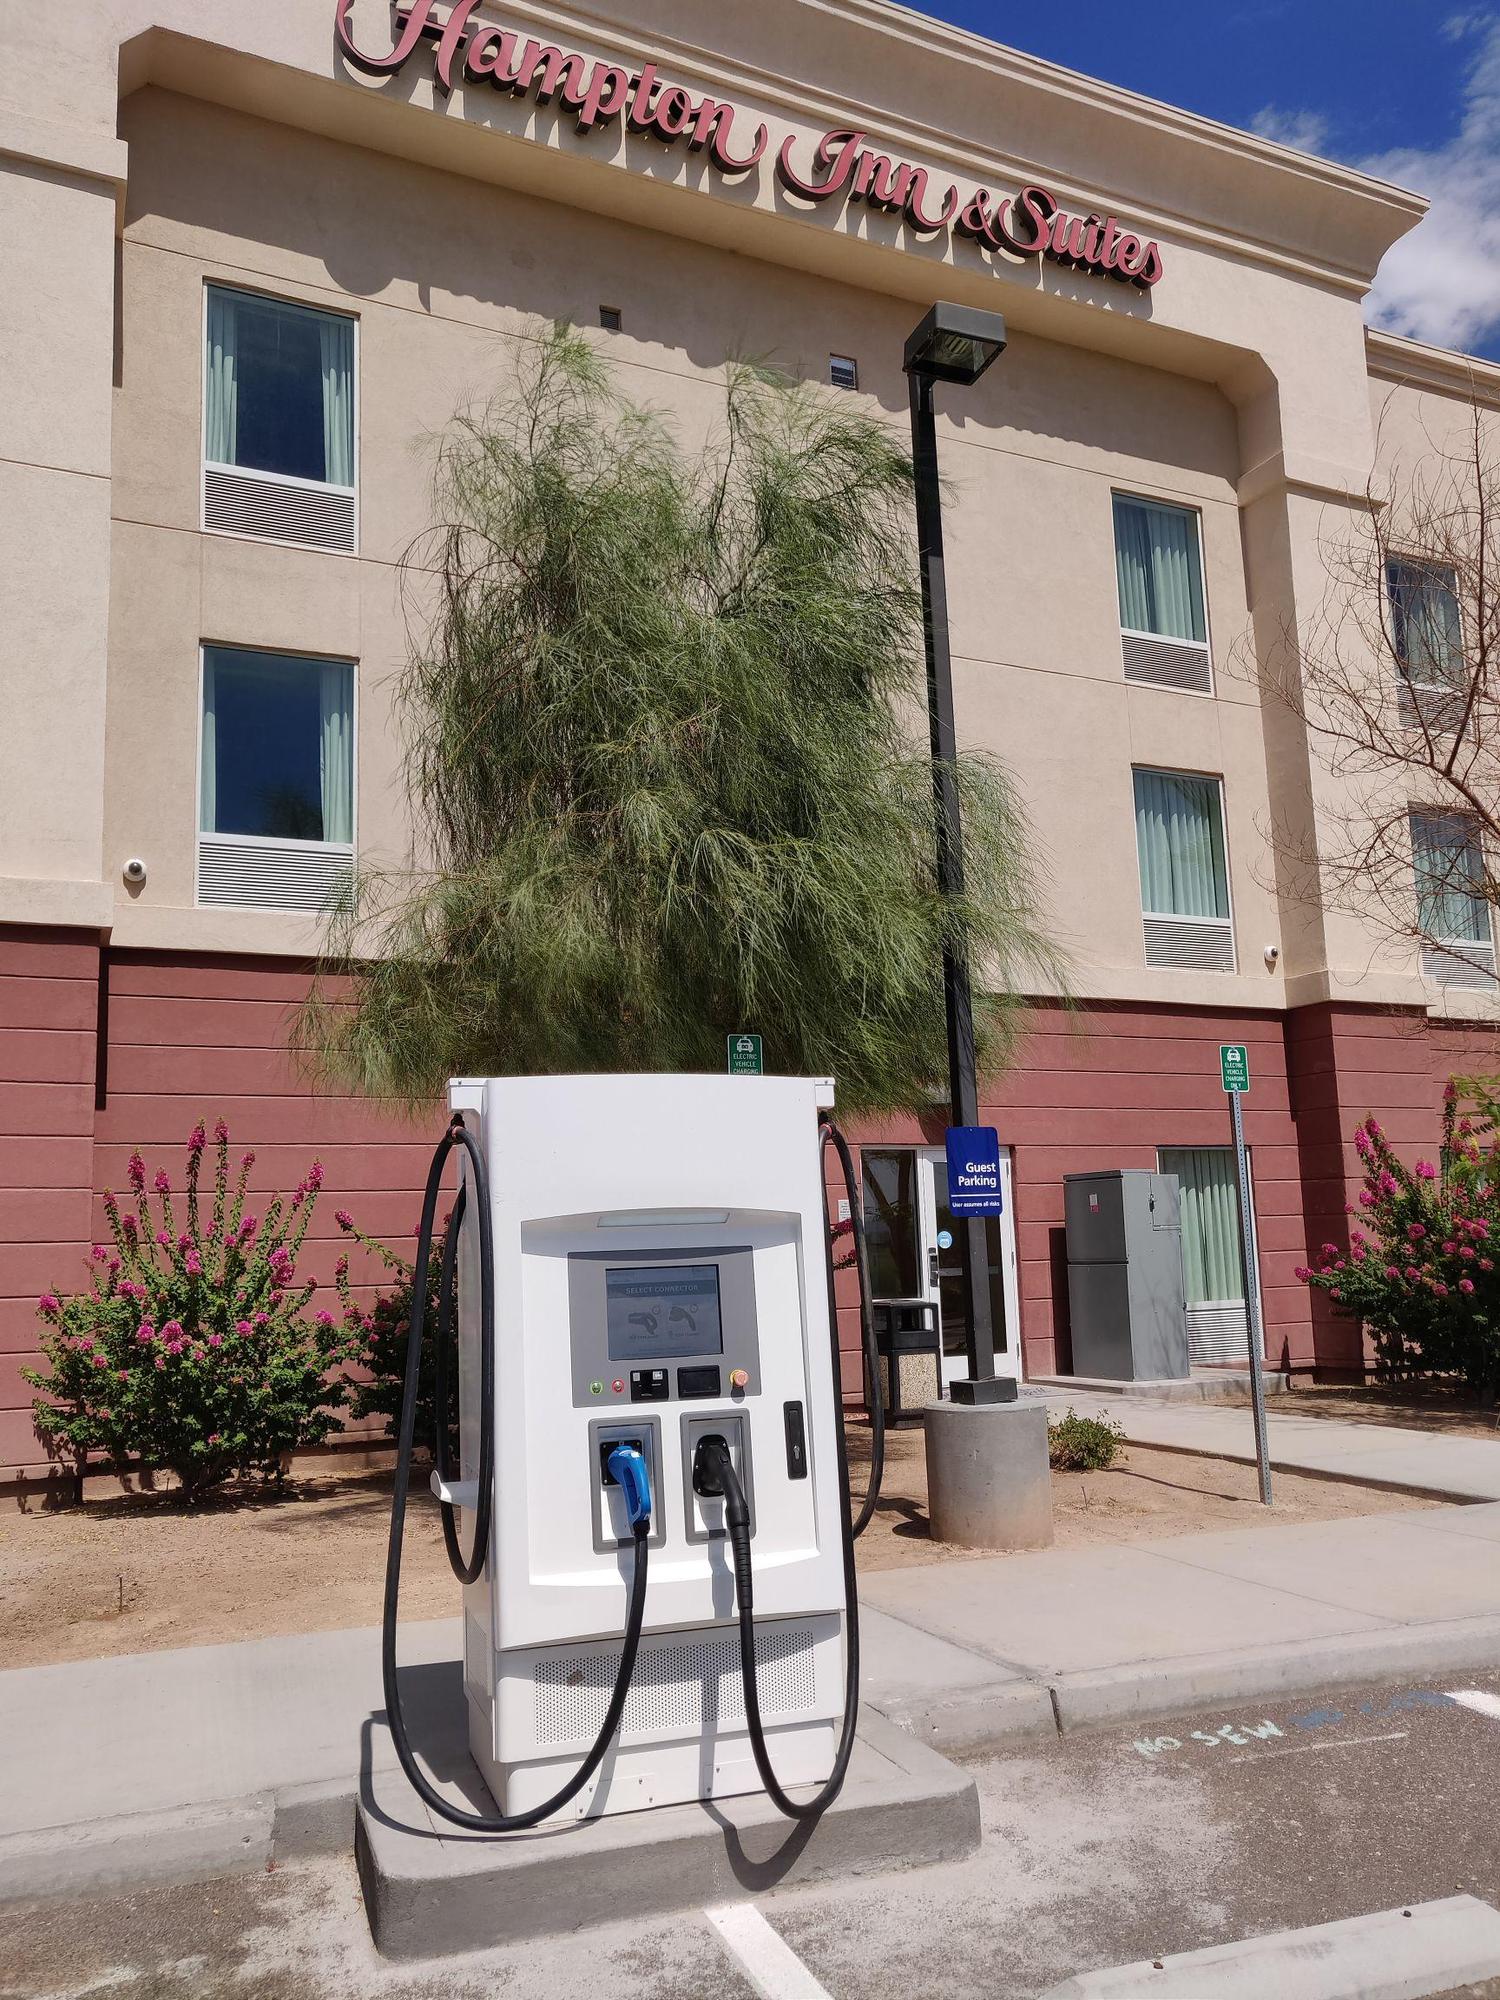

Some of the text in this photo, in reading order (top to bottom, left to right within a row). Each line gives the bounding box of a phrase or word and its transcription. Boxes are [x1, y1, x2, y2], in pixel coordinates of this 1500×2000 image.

[336, 0, 1163, 290] Hampton Inn & Suites
[966, 1162, 996, 1173] Guest
[958, 1175, 997, 1188] Parking
[625, 1284, 698, 1295] SELECT CONNECTOR
